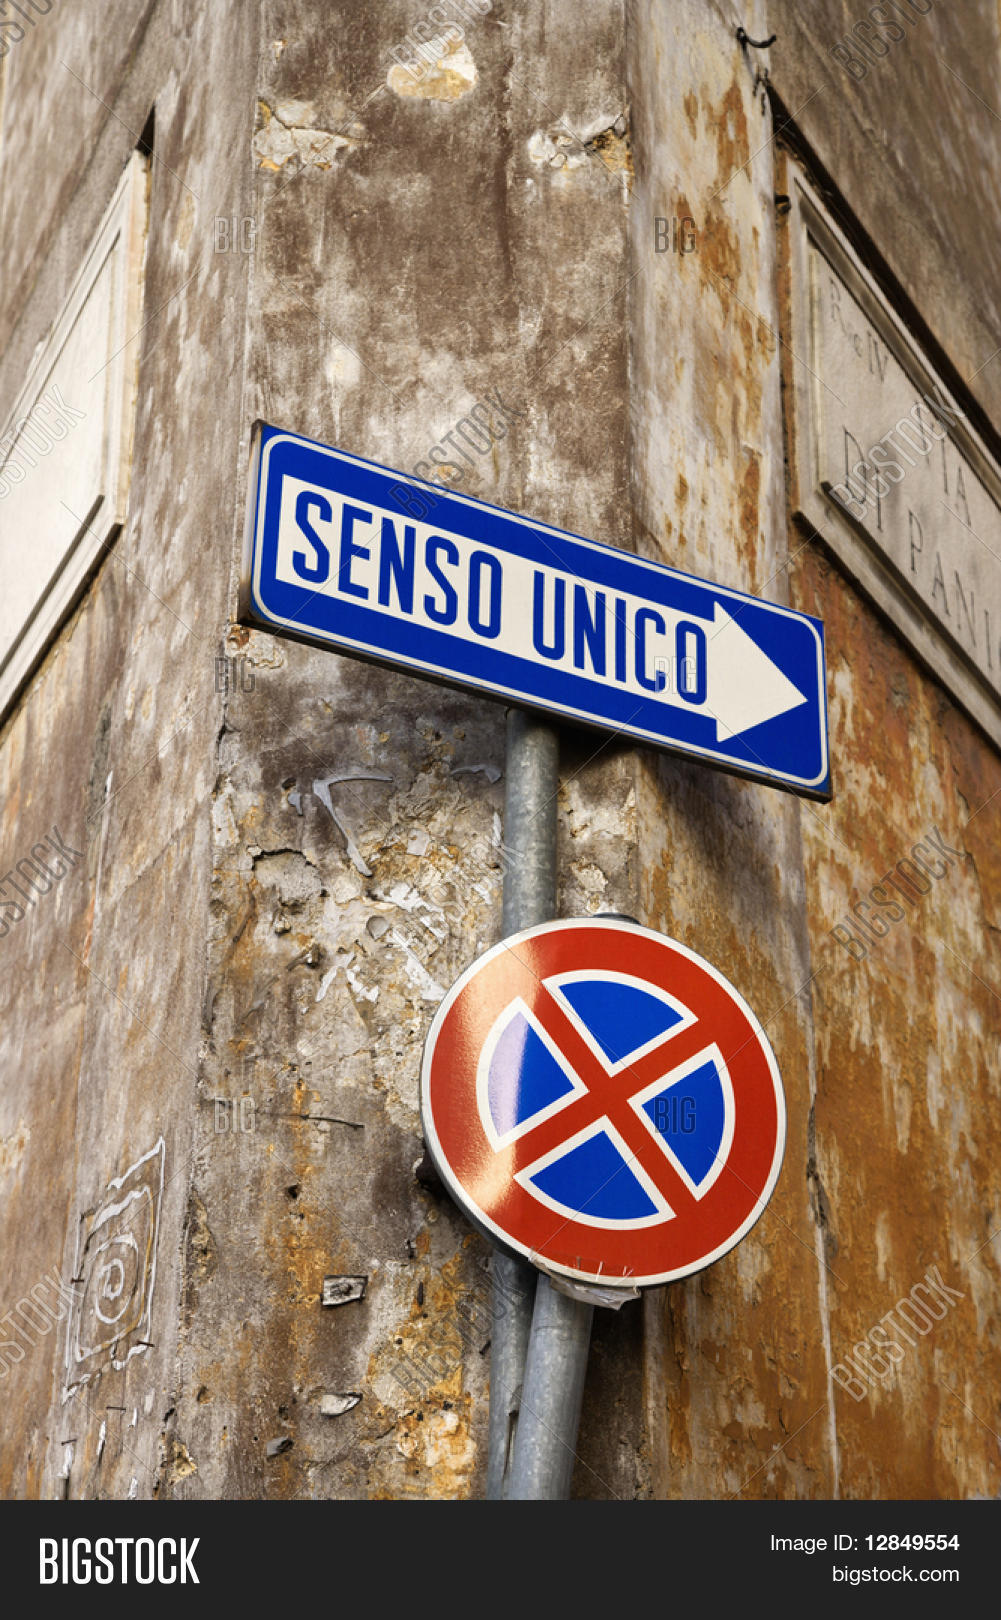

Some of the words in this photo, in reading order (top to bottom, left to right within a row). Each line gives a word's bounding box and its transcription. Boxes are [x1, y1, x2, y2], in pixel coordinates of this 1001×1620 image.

[292, 490, 503, 640] SENSO
[532, 569, 708, 706] UNICO
[842, 425, 884, 534] DI
[907, 508, 1001, 672] PANI
